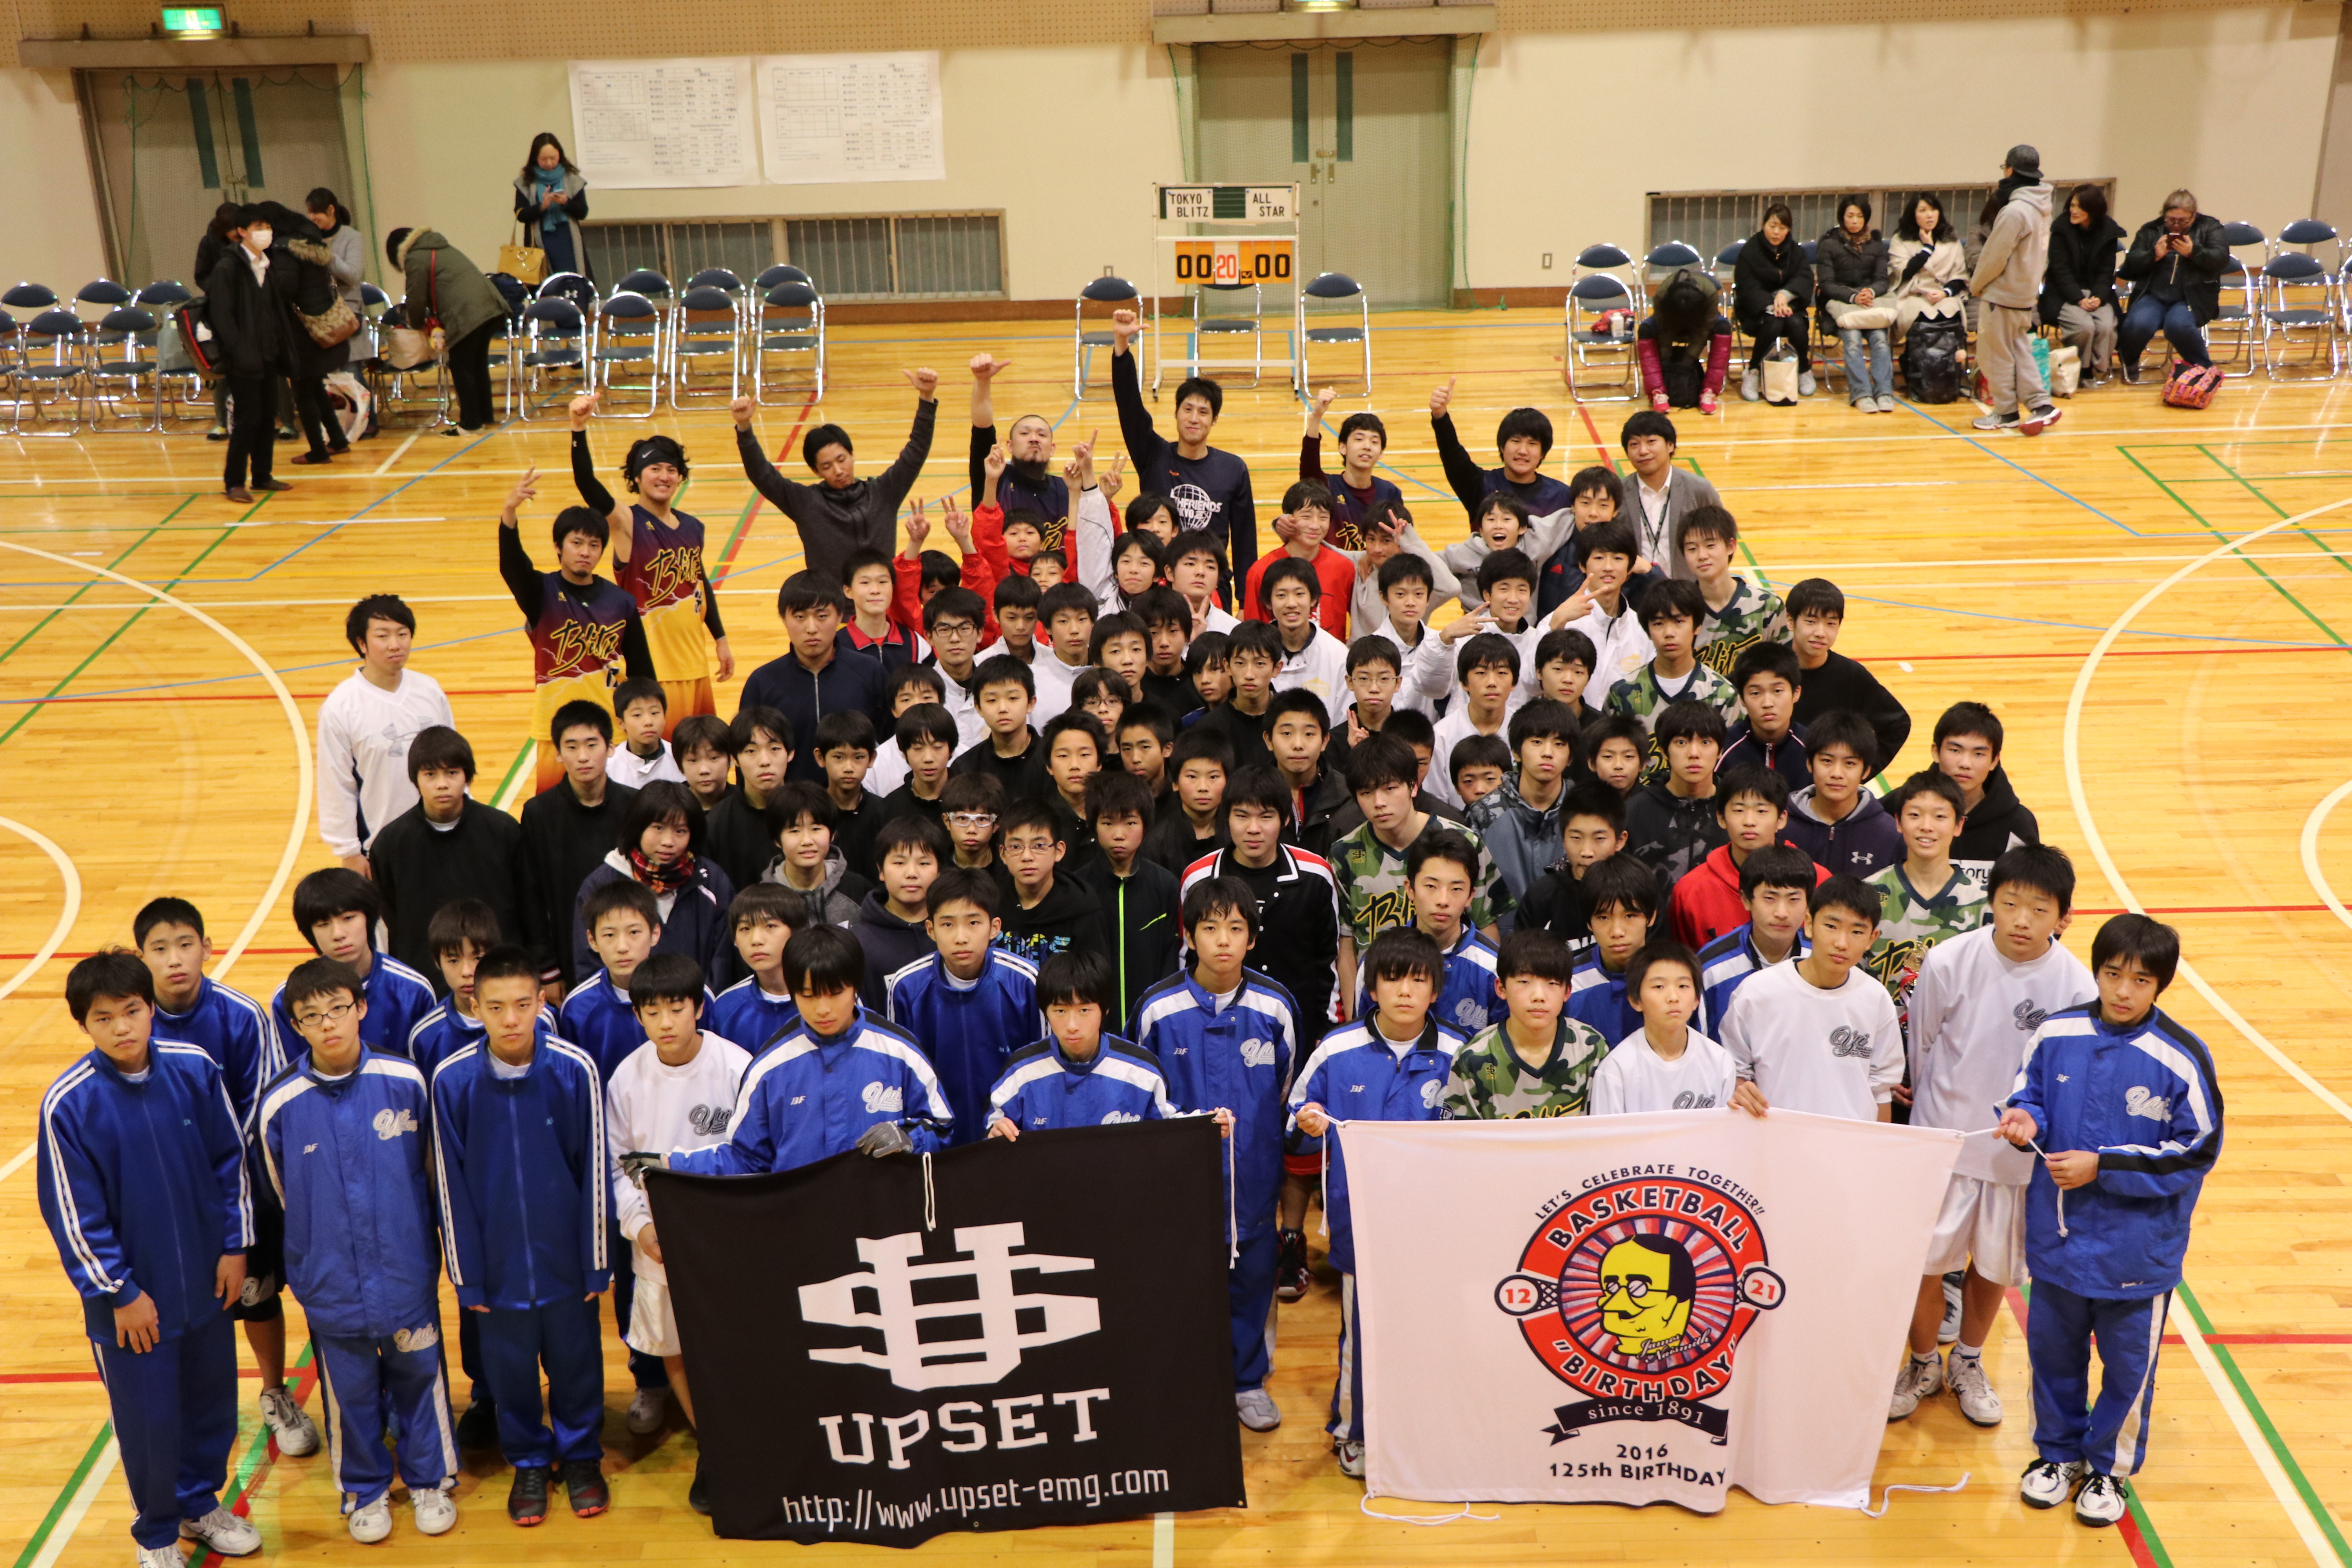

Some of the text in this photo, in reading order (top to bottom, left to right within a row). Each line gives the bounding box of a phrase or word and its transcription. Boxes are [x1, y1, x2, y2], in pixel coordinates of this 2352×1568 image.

[1170, 193, 1202, 204] TOKYO
[1253, 193, 1271, 203] ALL
[1177, 206, 1209, 217] BLITZ
[1259, 206, 1285, 216] STAR
[1216, 254, 1237, 279] 20
[1961, 864, 1991, 882] ory
[1350, 1085, 1366, 1093] BF
[790, 1096, 806, 1105] BF
[1033, 1117, 1047, 1125] BF
[303, 1143, 318, 1154] BF
[1534, 1163, 1766, 1220] LET'S CELEBRATE TOGETHER!!
[1546, 1187, 1751, 1252] BASKETBALL
[1505, 1289, 1532, 1304] 12
[1749, 1280, 1775, 1300] 21
[1637, 1333, 1682, 1360] James
[1644, 1328, 1711, 1364] Naismith
[1588, 1401, 1704, 1425] since 1891
[818, 1388, 1110, 1470] UPSET
[1616, 1444, 1668, 1460] 2016
[1550, 1462, 1726, 1486] 125th BIRTHDAY
[782, 1467, 1170, 1532] http://www.upset-emg.com
